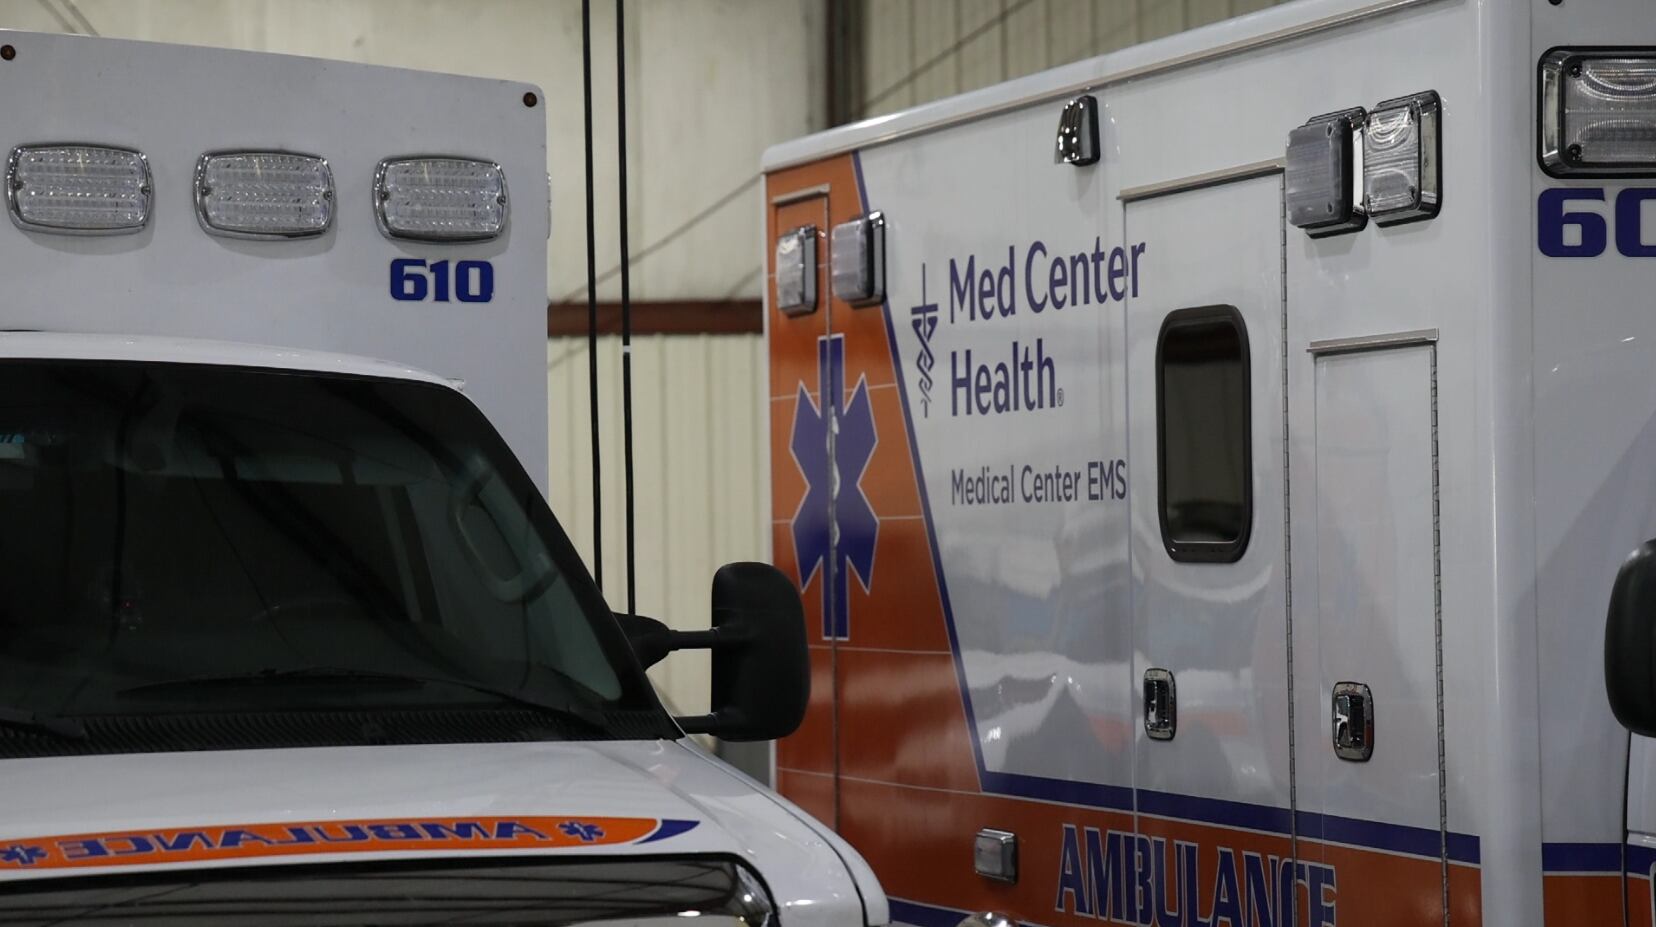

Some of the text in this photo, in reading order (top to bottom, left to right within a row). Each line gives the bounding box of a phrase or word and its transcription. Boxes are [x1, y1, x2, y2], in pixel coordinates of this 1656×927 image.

[390, 258, 494, 303] 610
[950, 236, 1146, 324] Med Center
[951, 459, 1127, 505] Medical Center EMS
[1055, 823, 1337, 927] AMBULANCE
